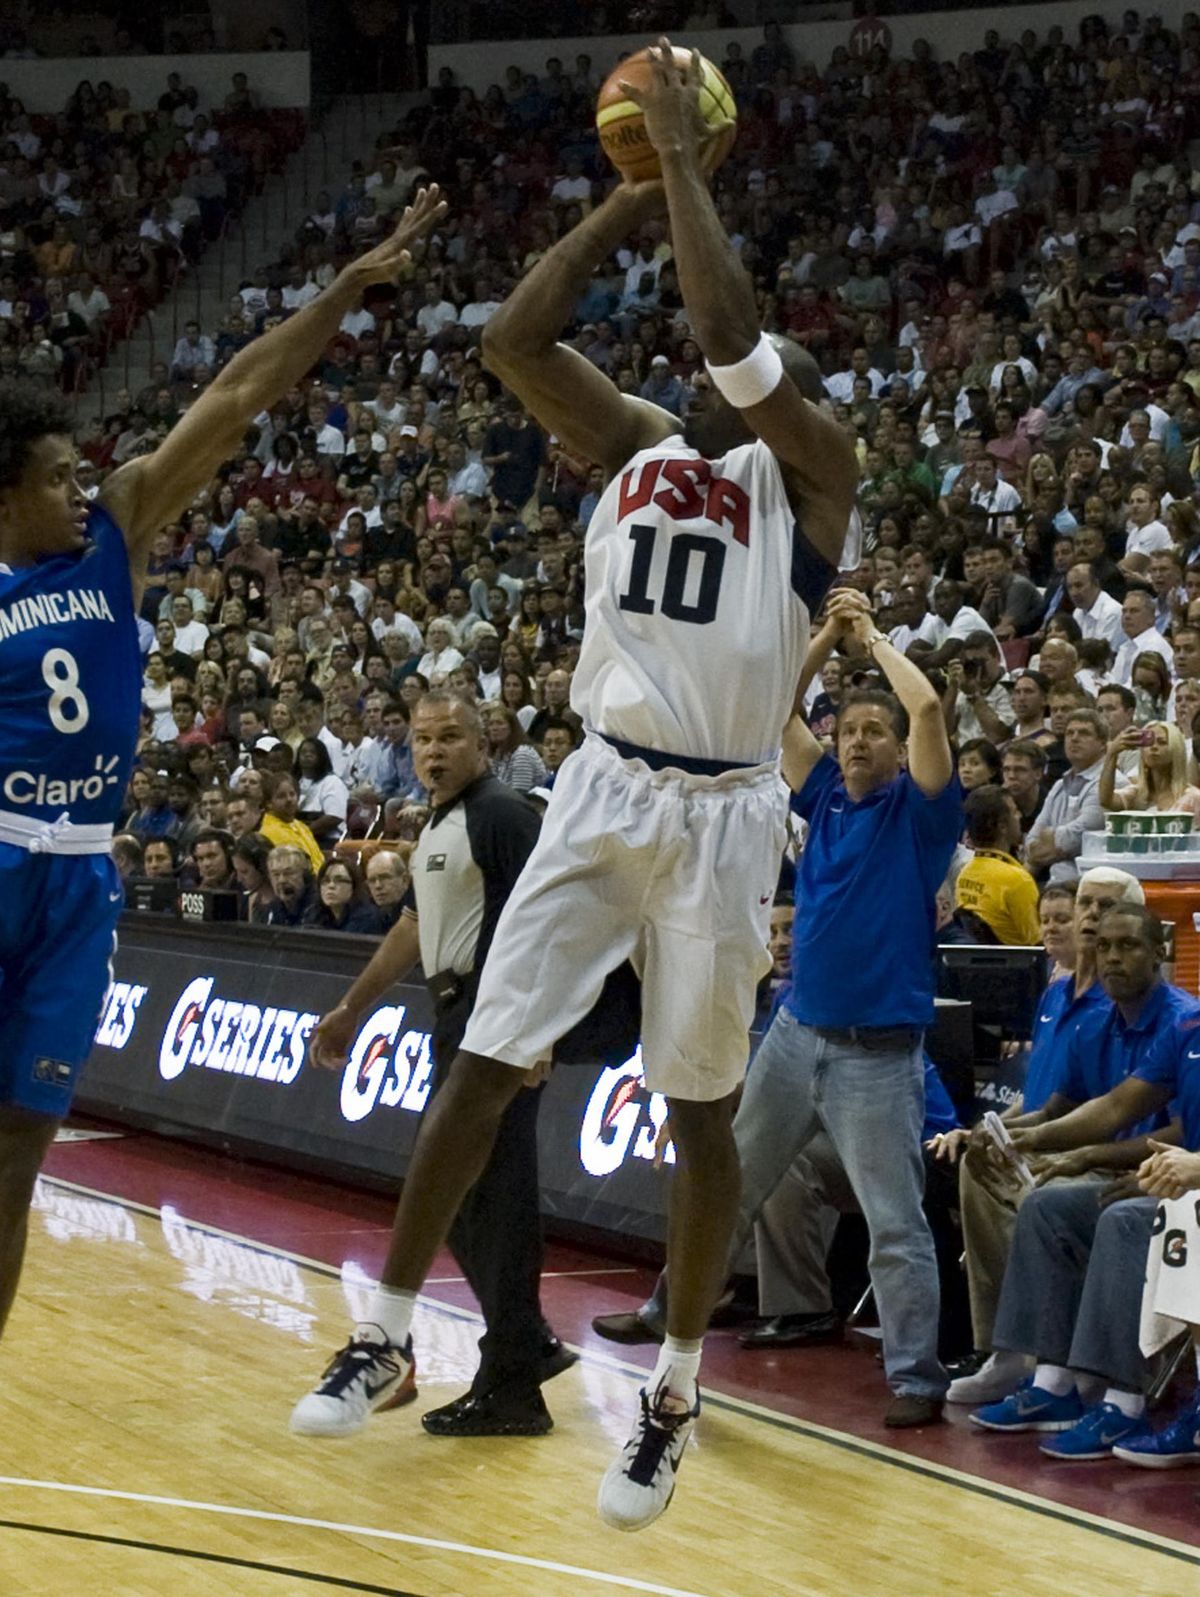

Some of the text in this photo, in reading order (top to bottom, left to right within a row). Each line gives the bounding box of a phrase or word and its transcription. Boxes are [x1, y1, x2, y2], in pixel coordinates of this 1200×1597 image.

[617, 458, 751, 549] USA
[620, 524, 727, 625] 10
[41, 648, 89, 734] 8
[4, 770, 104, 806] Claro
[181, 892, 204, 914] POSS
